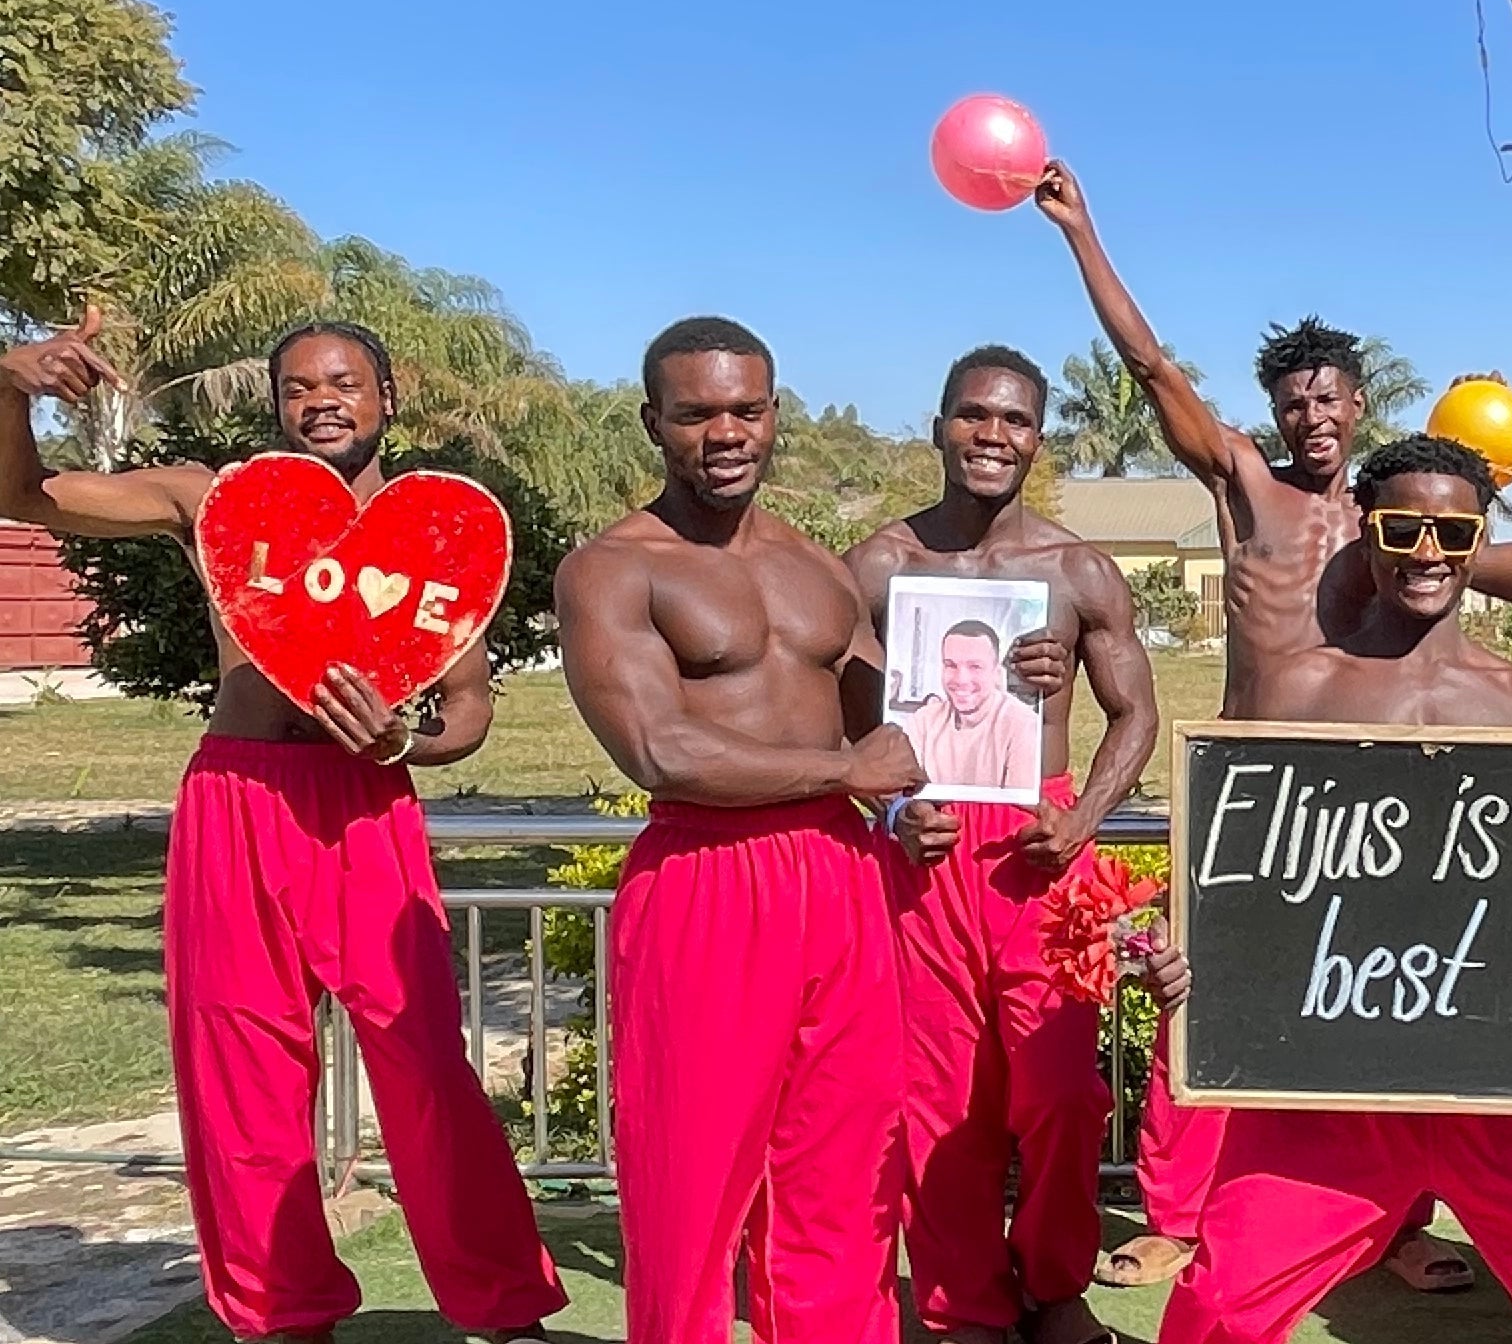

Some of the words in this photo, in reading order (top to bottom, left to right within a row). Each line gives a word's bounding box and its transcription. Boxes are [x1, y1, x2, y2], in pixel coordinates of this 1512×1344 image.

[1198, 763, 1411, 905] Elijus
[1432, 774, 1511, 882] is
[1300, 894, 1489, 1022] best
